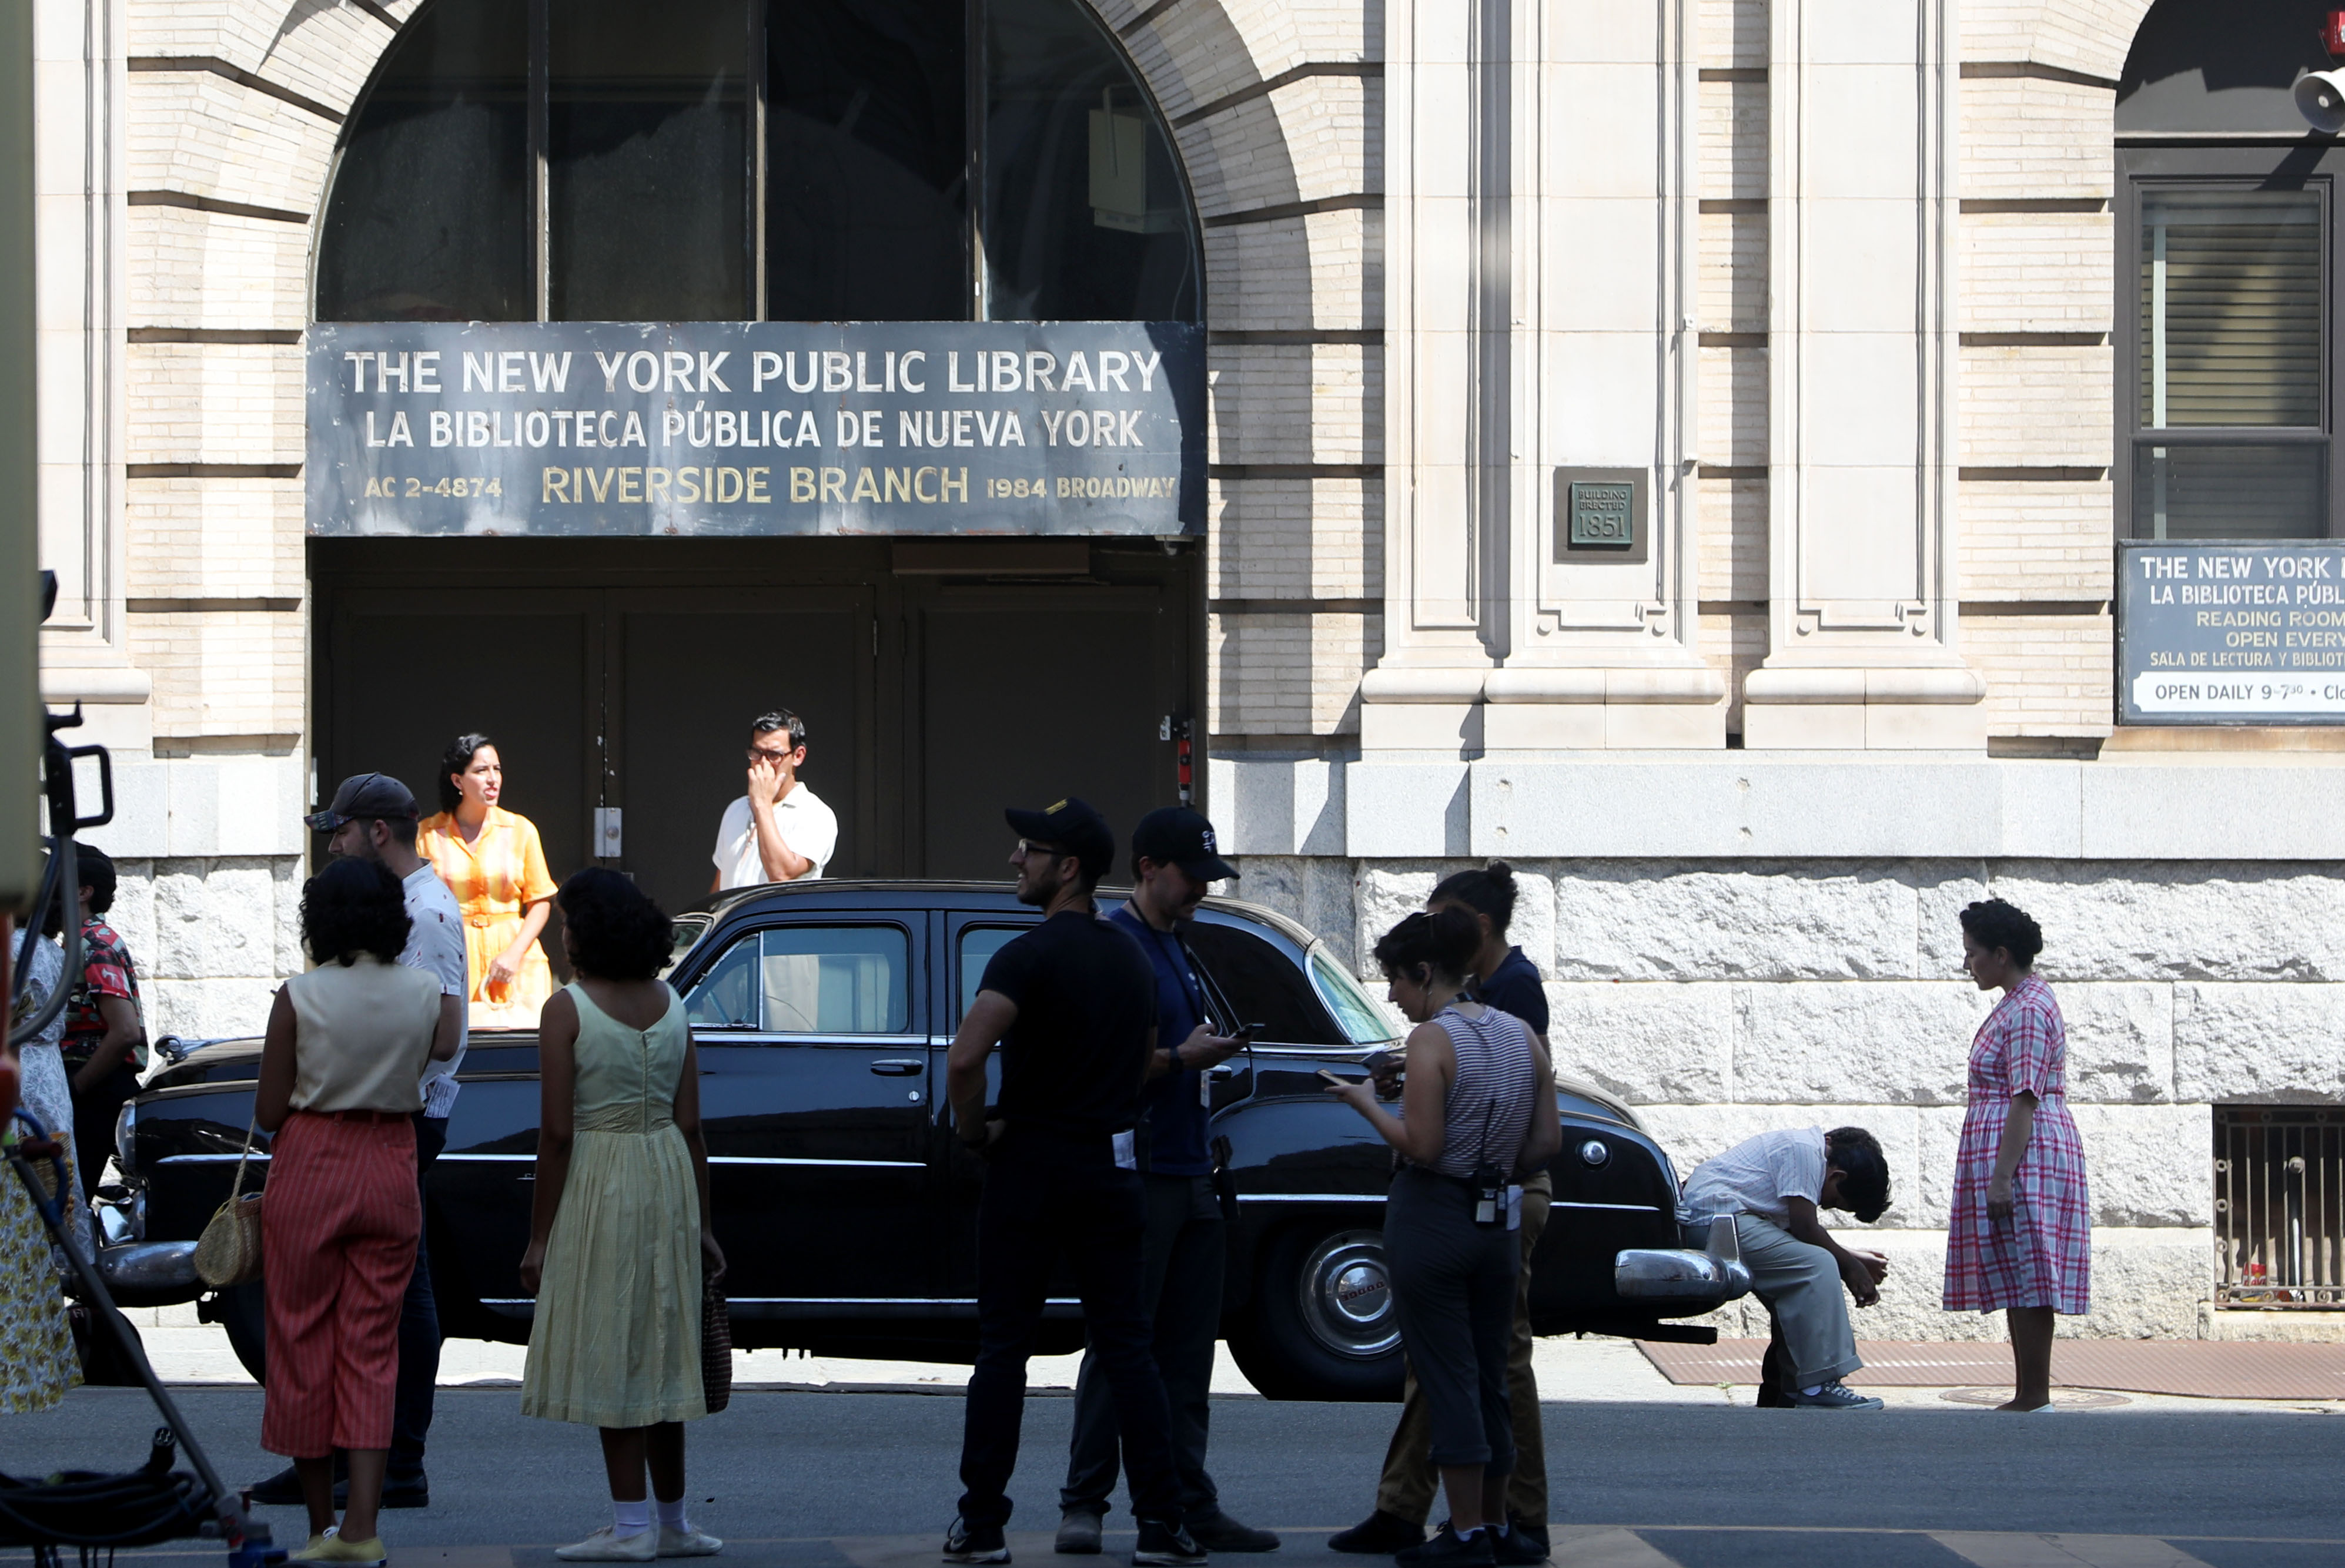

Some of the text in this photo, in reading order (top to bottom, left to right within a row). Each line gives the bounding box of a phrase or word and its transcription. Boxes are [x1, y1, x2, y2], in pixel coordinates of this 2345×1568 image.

[344, 350, 1164, 393] THE NEW YORK PUBLIC LIBRARY
[366, 400, 1144, 449] LA BIBLIOTECA PÚBLICA DE NUEVA YORK
[363, 477, 503, 498] AC 2-4874
[541, 466, 969, 504] RIVERSIDE BRANCH
[986, 477, 1176, 499] 1984 BROADWAY
[1578, 489, 1627, 500] BUILDING
[1578, 500, 1627, 510] ERECTED
[1578, 514, 1626, 537] 1851
[2140, 557, 2188, 578] THE
[2197, 557, 2253, 578] NEW
[2263, 557, 2331, 579] YORK
[2150, 585, 2175, 605] LA
[2182, 585, 2289, 605] BIBLIOTECA
[2196, 611, 2282, 627] READING
[2226, 631, 2278, 647] OPEN
[2150, 652, 2345, 666] SALA DE LECTURA Y BIBLIOT
[2155, 685, 2200, 700] OPEN
[2207, 685, 2254, 699] DAILY
[1340, 1281, 1385, 1302] DODGE
